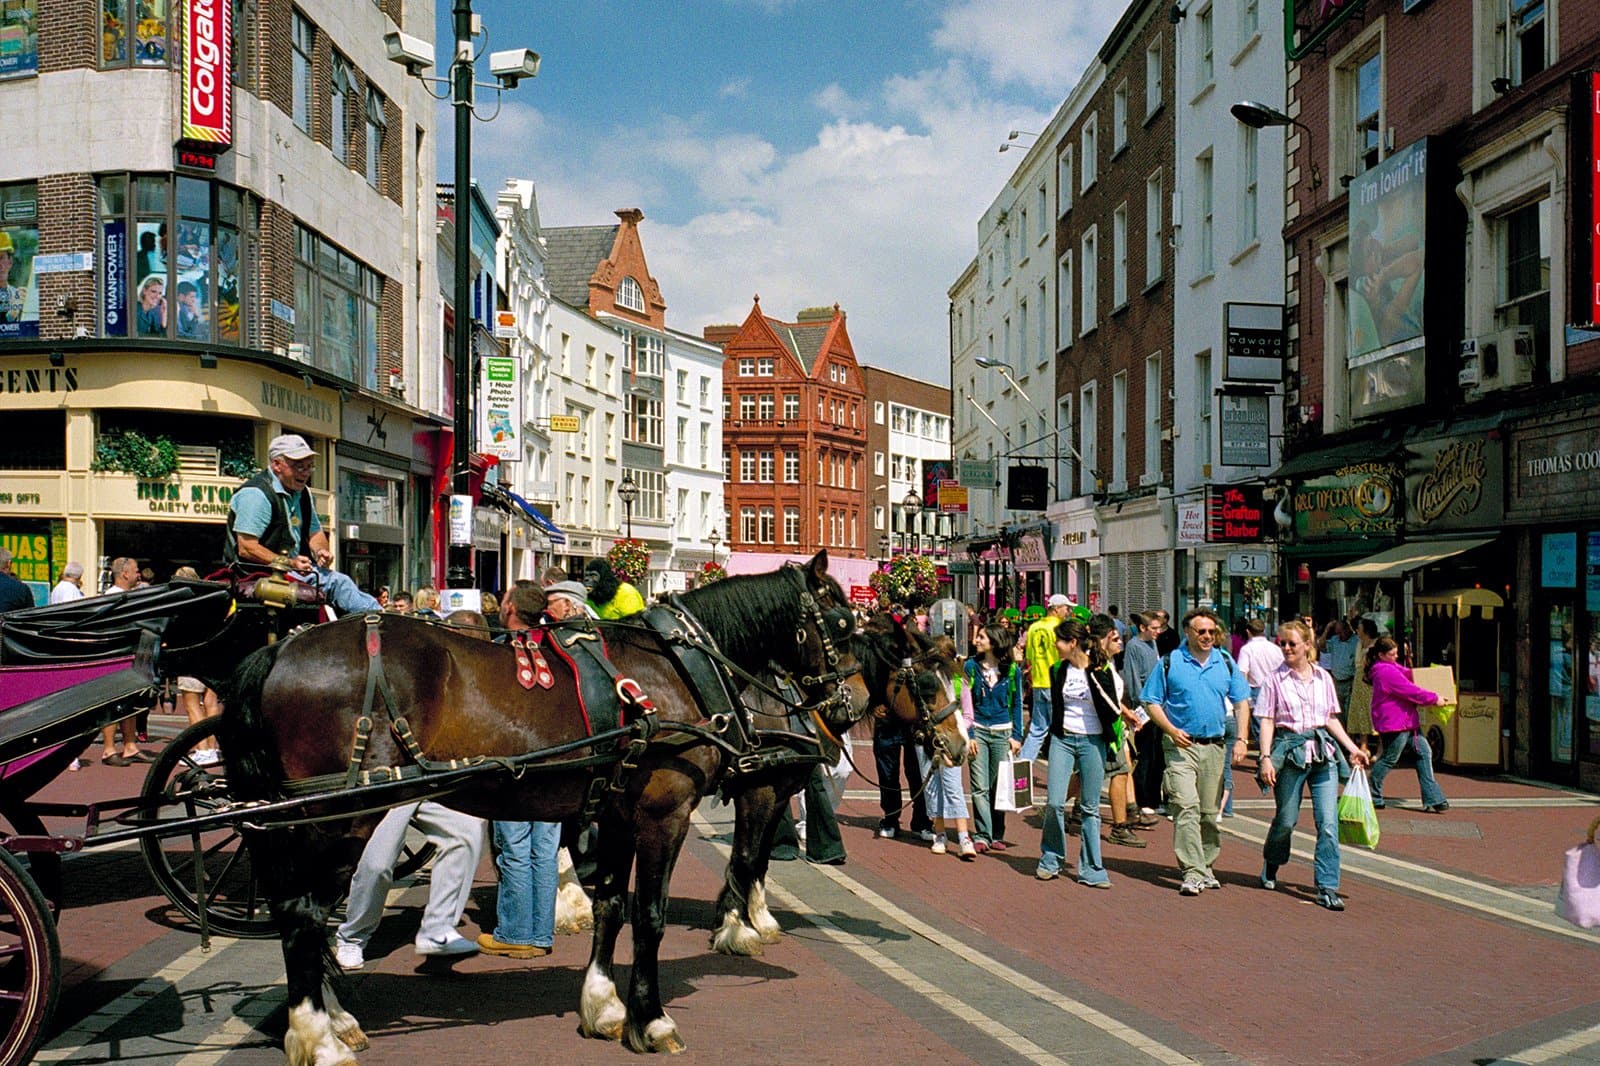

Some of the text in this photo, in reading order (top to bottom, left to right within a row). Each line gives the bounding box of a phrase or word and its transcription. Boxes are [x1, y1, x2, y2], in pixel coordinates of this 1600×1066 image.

[1380, 155, 1413, 196] lovin'
[1415, 149, 1425, 176] it
[107, 234, 117, 310] MANPOWER
[1229, 337, 1281, 347] edward
[262, 381, 333, 424] NEWSAGENTS
[487, 395, 515, 403] Service
[1527, 454, 1572, 477] THOMAS
[16, 493, 41, 504] GIFTS
[191, 485, 236, 503] STO
[1224, 489, 1245, 502] The
[149, 501, 230, 515] GAIETY CORNE
[1185, 511, 1199, 520] Hot
[1222, 504, 1260, 520] Grafton
[1182, 520, 1203, 530] Towel
[1225, 522, 1259, 537] Barber
[3, 535, 48, 560] UAS
[1240, 555, 1256, 570] 51
